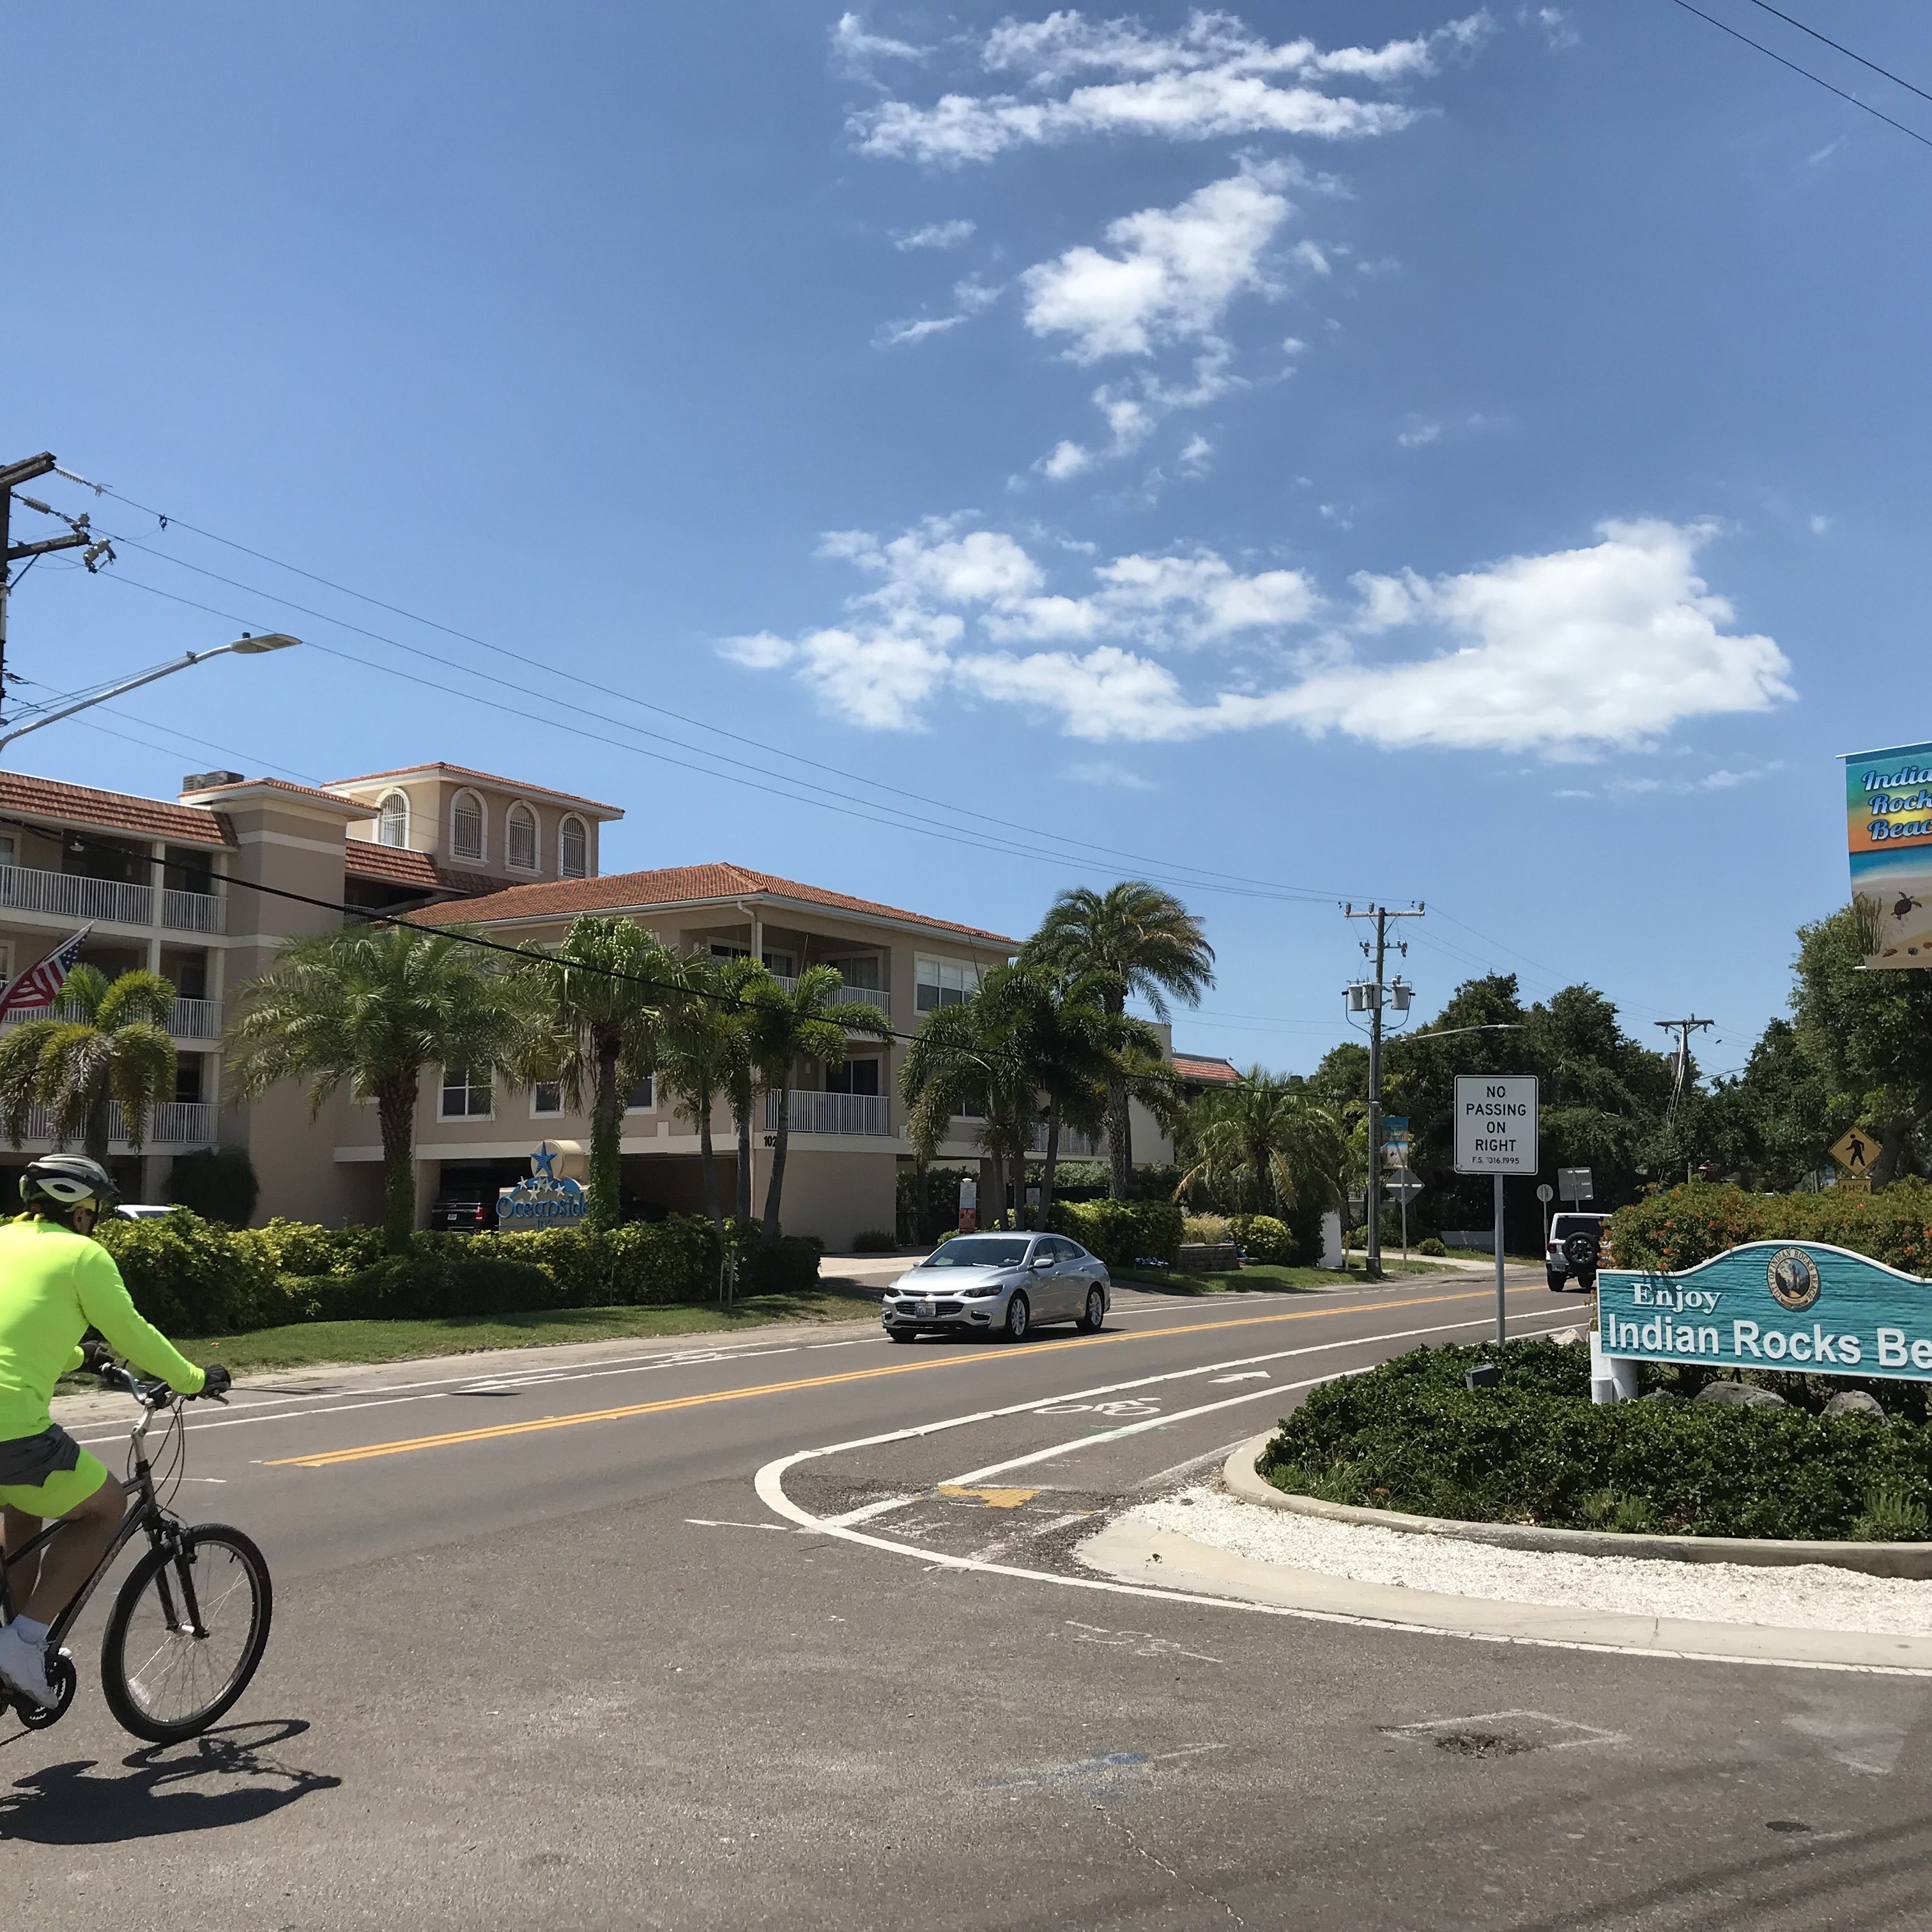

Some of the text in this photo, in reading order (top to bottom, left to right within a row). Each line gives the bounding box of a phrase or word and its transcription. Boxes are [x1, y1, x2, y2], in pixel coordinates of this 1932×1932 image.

[1862, 765, 1932, 790] India
[1486, 1085, 1506, 1098] NO
[1466, 1103, 1526, 1116] PASSING
[1486, 1121, 1506, 1133] ON
[763, 1135, 778, 1147] 102
[1475, 1139, 1516, 1151] RIGHT
[1770, 1250, 1791, 1269] INDIAN
[1793, 1250, 1814, 1271] ROCKS
[1768, 1268, 1775, 1280] OF
[1769, 1282, 1782, 1298] CITY
[1630, 1282, 1722, 1314] Enjoy
[1609, 1314, 1932, 1370] Indian Rocks Be
